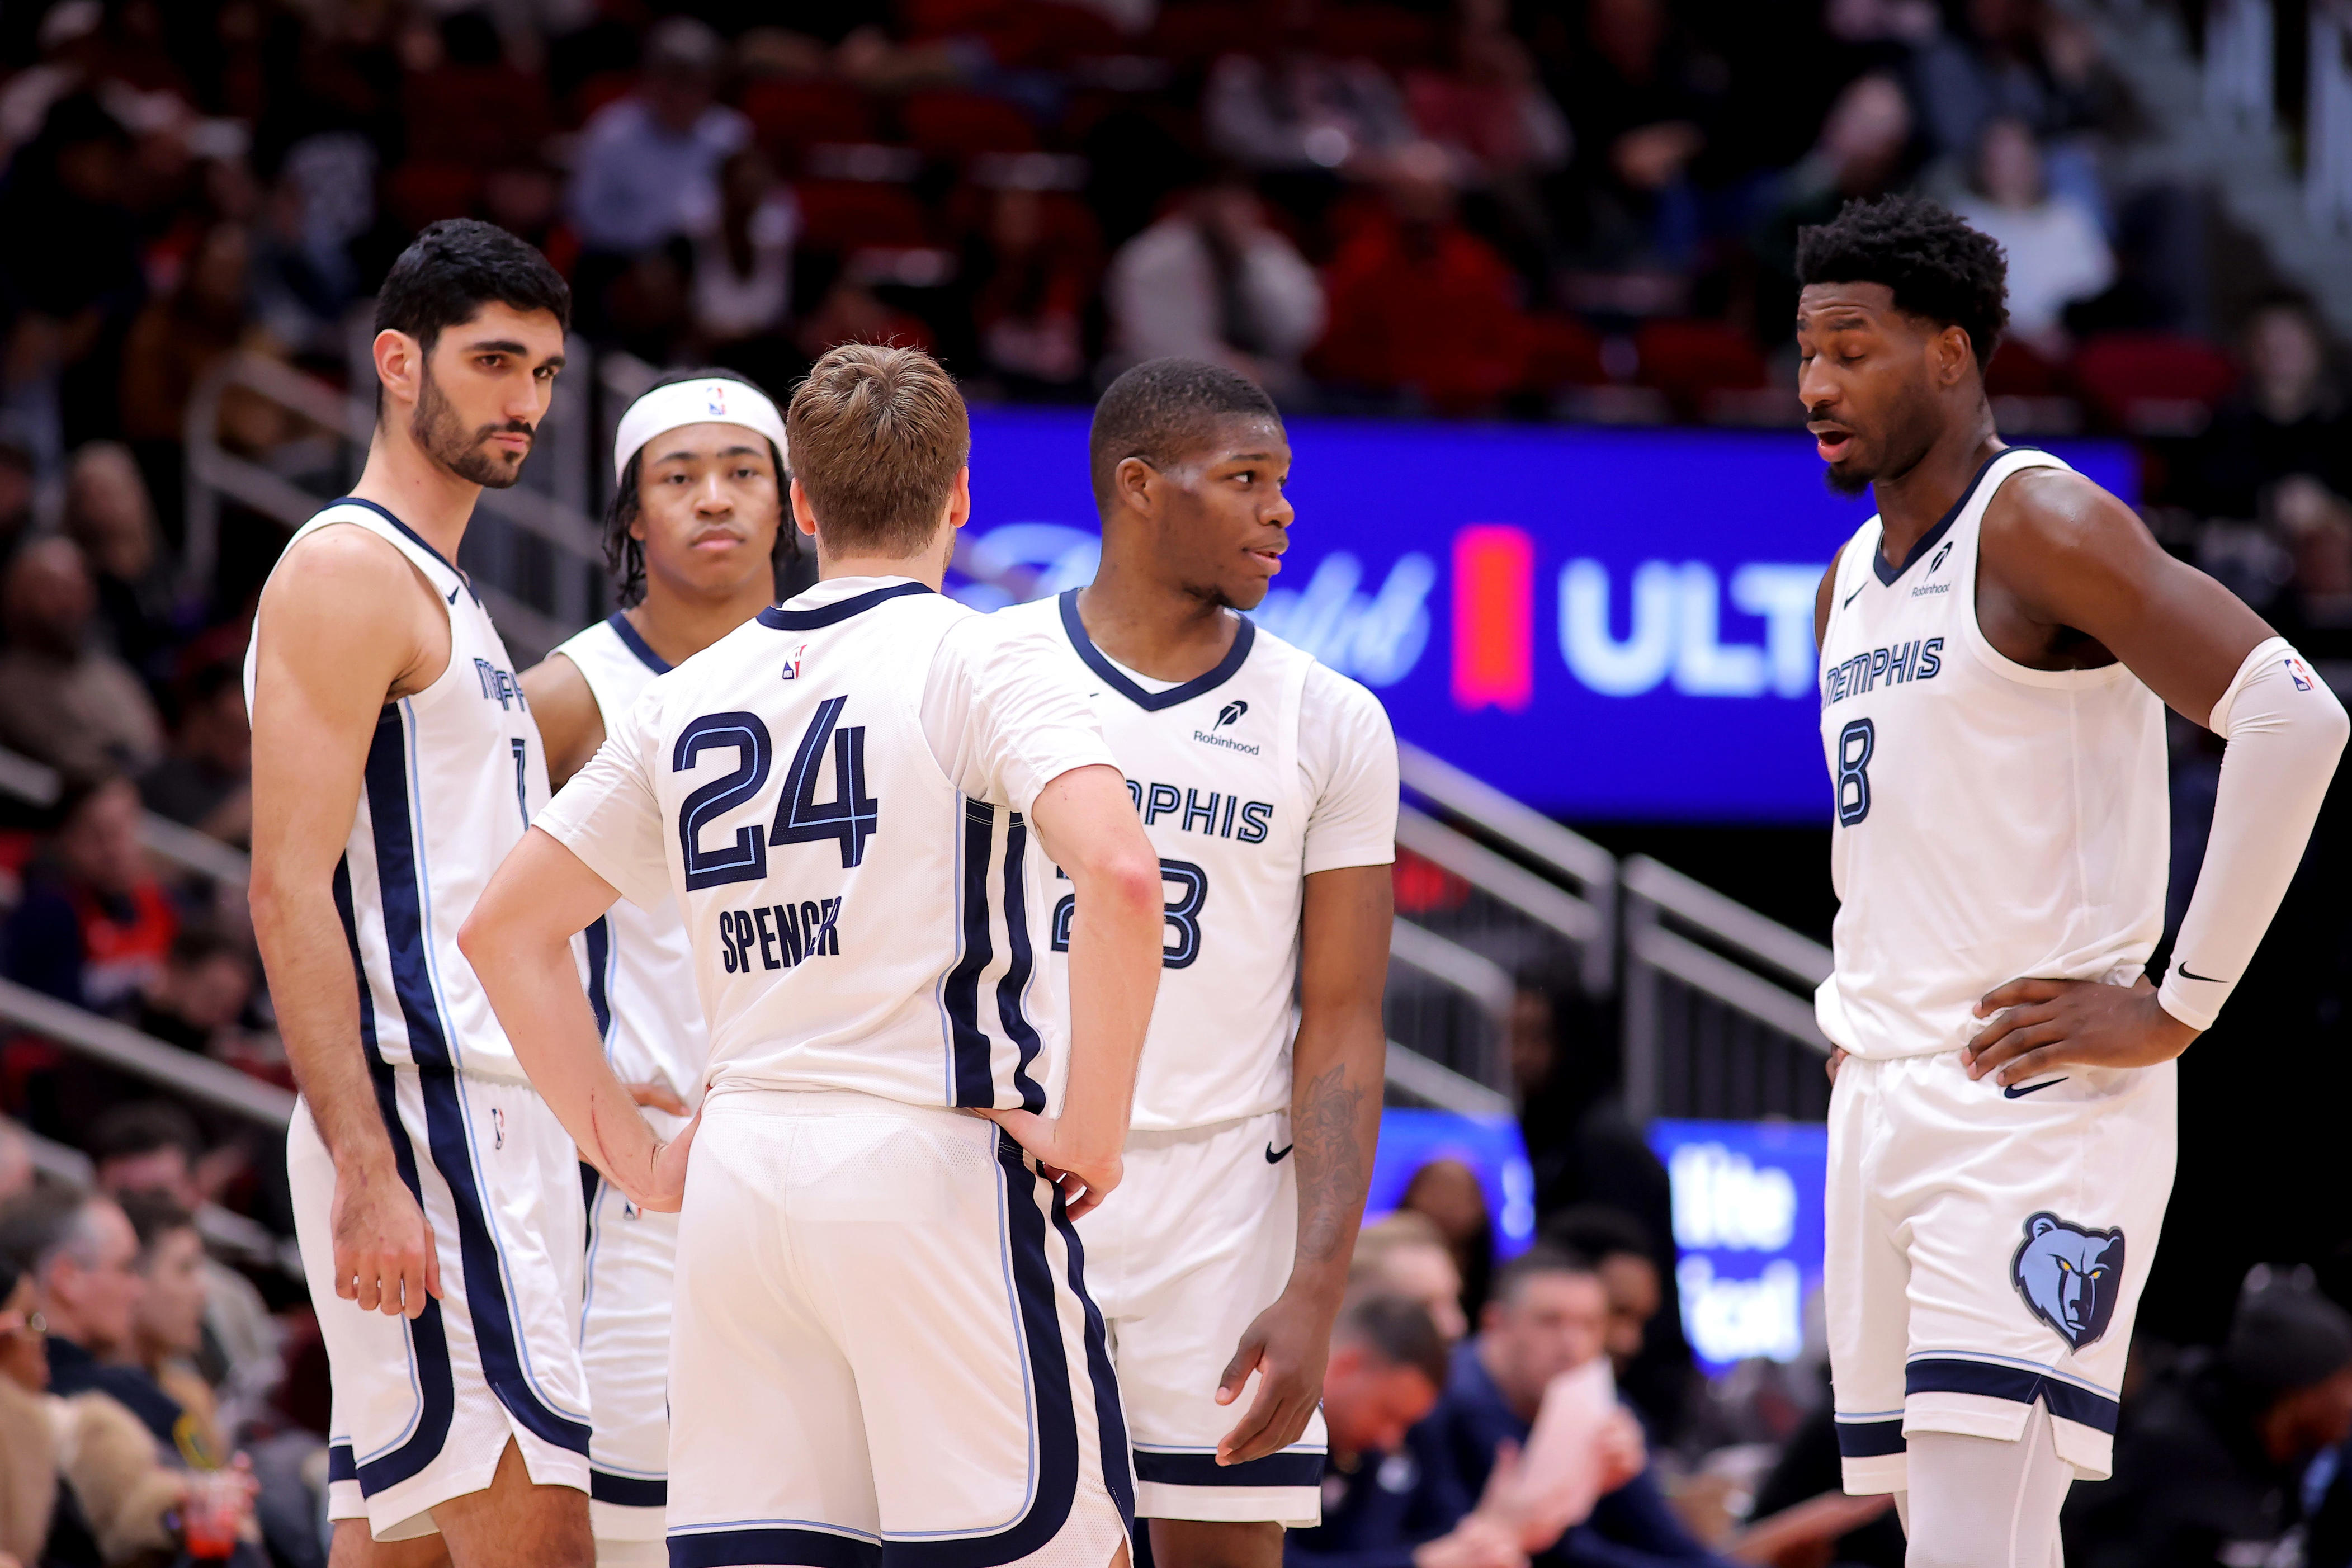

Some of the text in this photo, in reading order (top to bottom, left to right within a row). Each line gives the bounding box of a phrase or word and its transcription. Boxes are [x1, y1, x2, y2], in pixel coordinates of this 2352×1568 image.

[1821, 637, 1944, 711] MEMPHIS
[1194, 730, 1260, 755] Robinhood
[1838, 717, 1874, 828] 8
[673, 695, 877, 892] 24
[1125, 779, 1274, 844] PHIS
